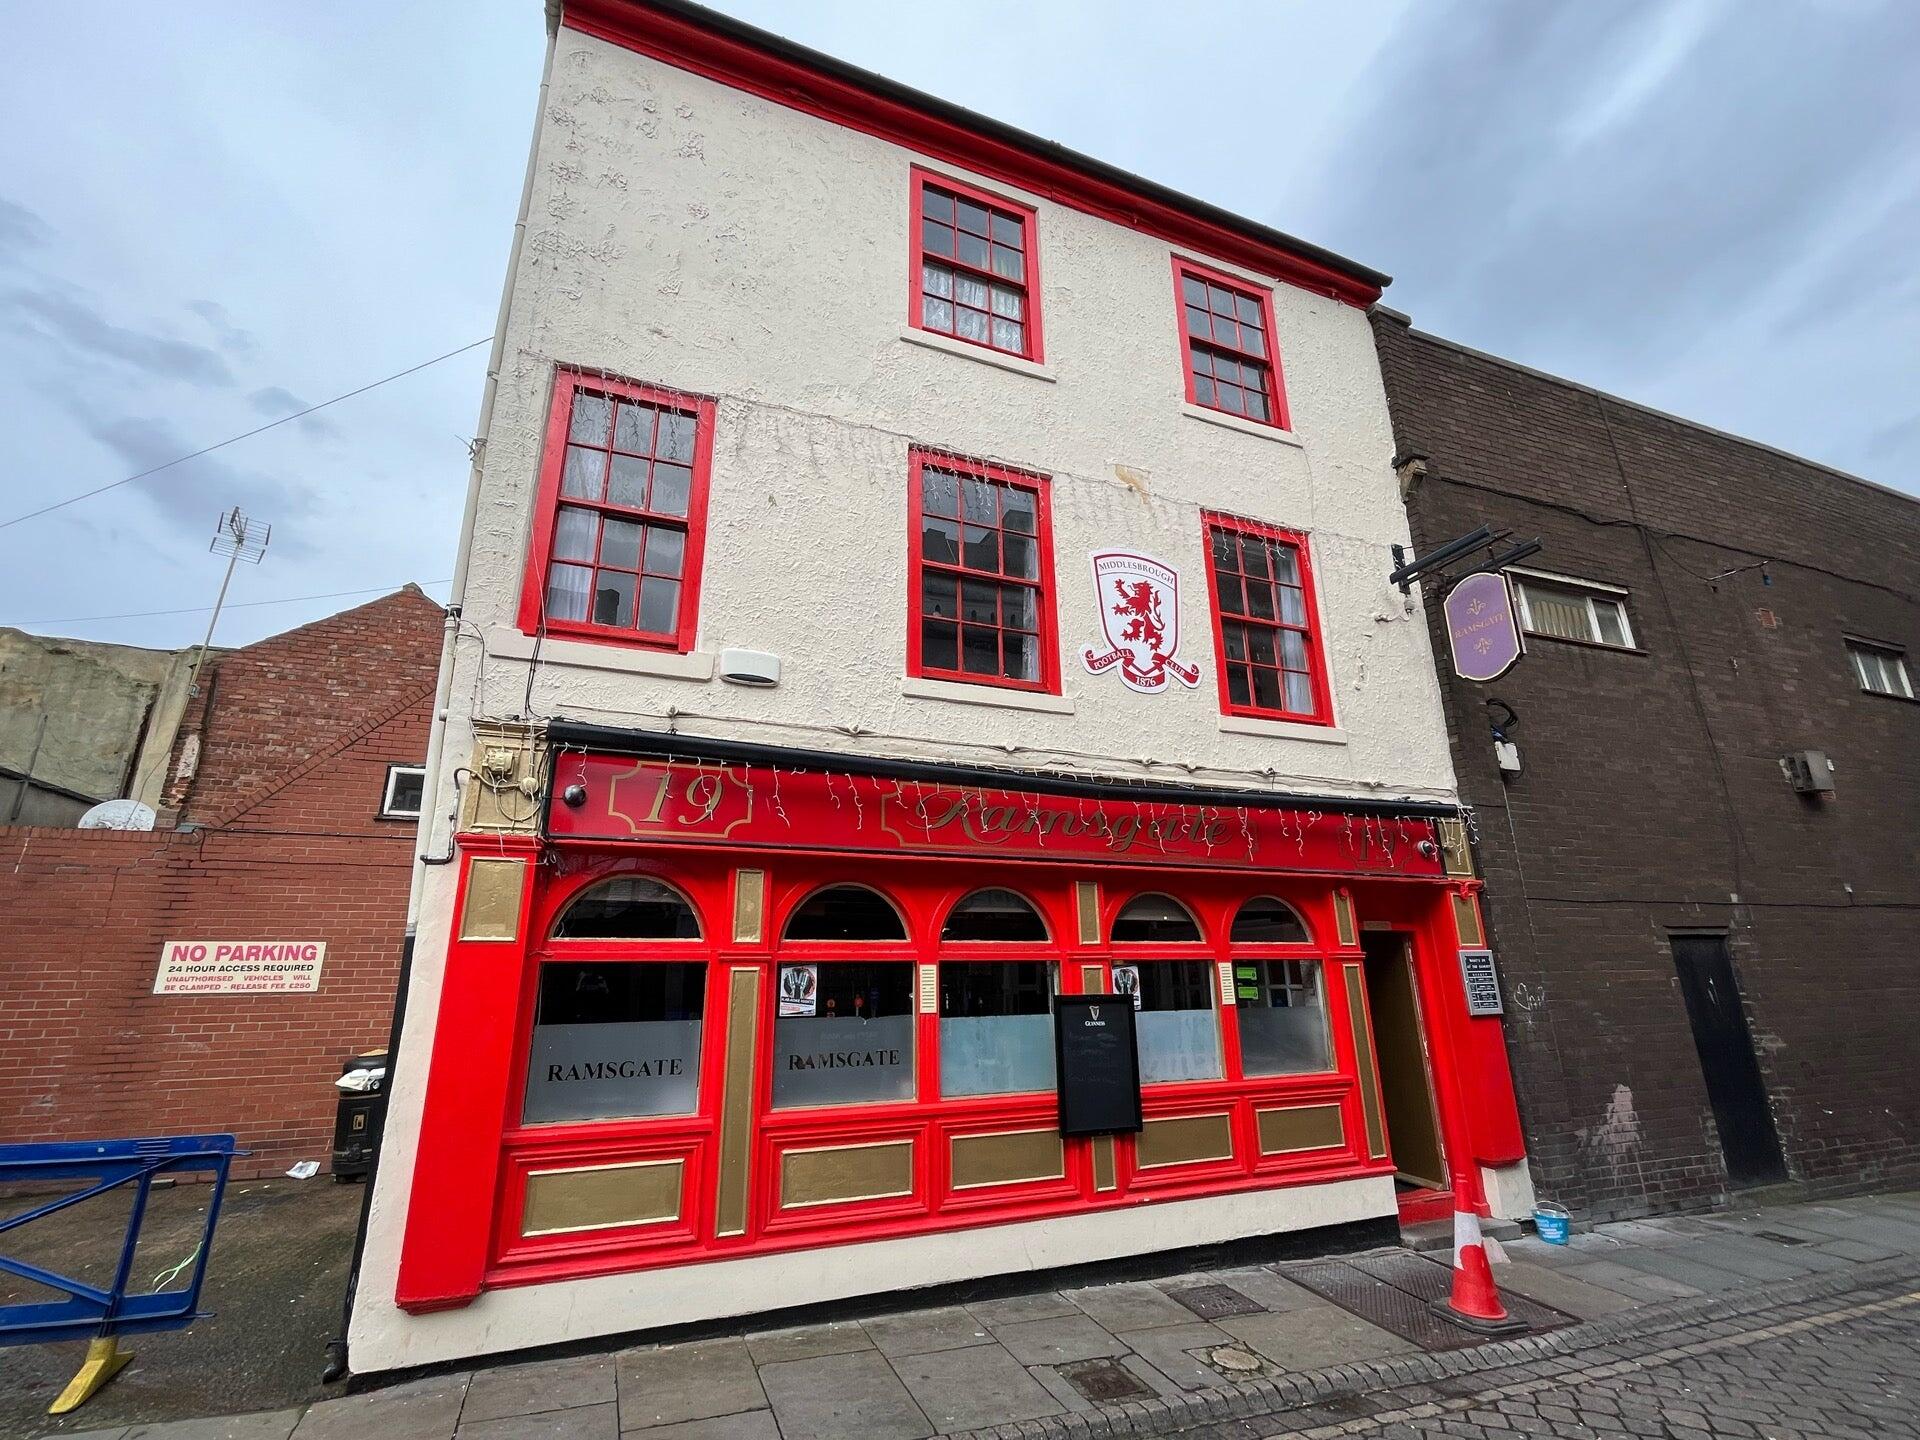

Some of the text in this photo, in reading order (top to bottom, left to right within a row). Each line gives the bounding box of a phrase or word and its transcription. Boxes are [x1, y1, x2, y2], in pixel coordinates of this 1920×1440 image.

[1098, 560, 1174, 584] MIDDLESBROUGH
[1454, 613, 1505, 638] RAMSGATE
[1093, 650, 1132, 670] FOOTBALL
[1165, 659, 1185, 677] CLUB
[1135, 676, 1156, 687] 1876
[638, 774, 725, 826] 19
[906, 789, 1234, 853] Ramsgate
[171, 944, 317, 962] NO PARKING
[168, 964, 314, 973] 24 HOUR ACCESS REQUIRED
[788, 1049, 901, 1071] RAMSGATE
[546, 1059, 684, 1083] RAMSGATE
